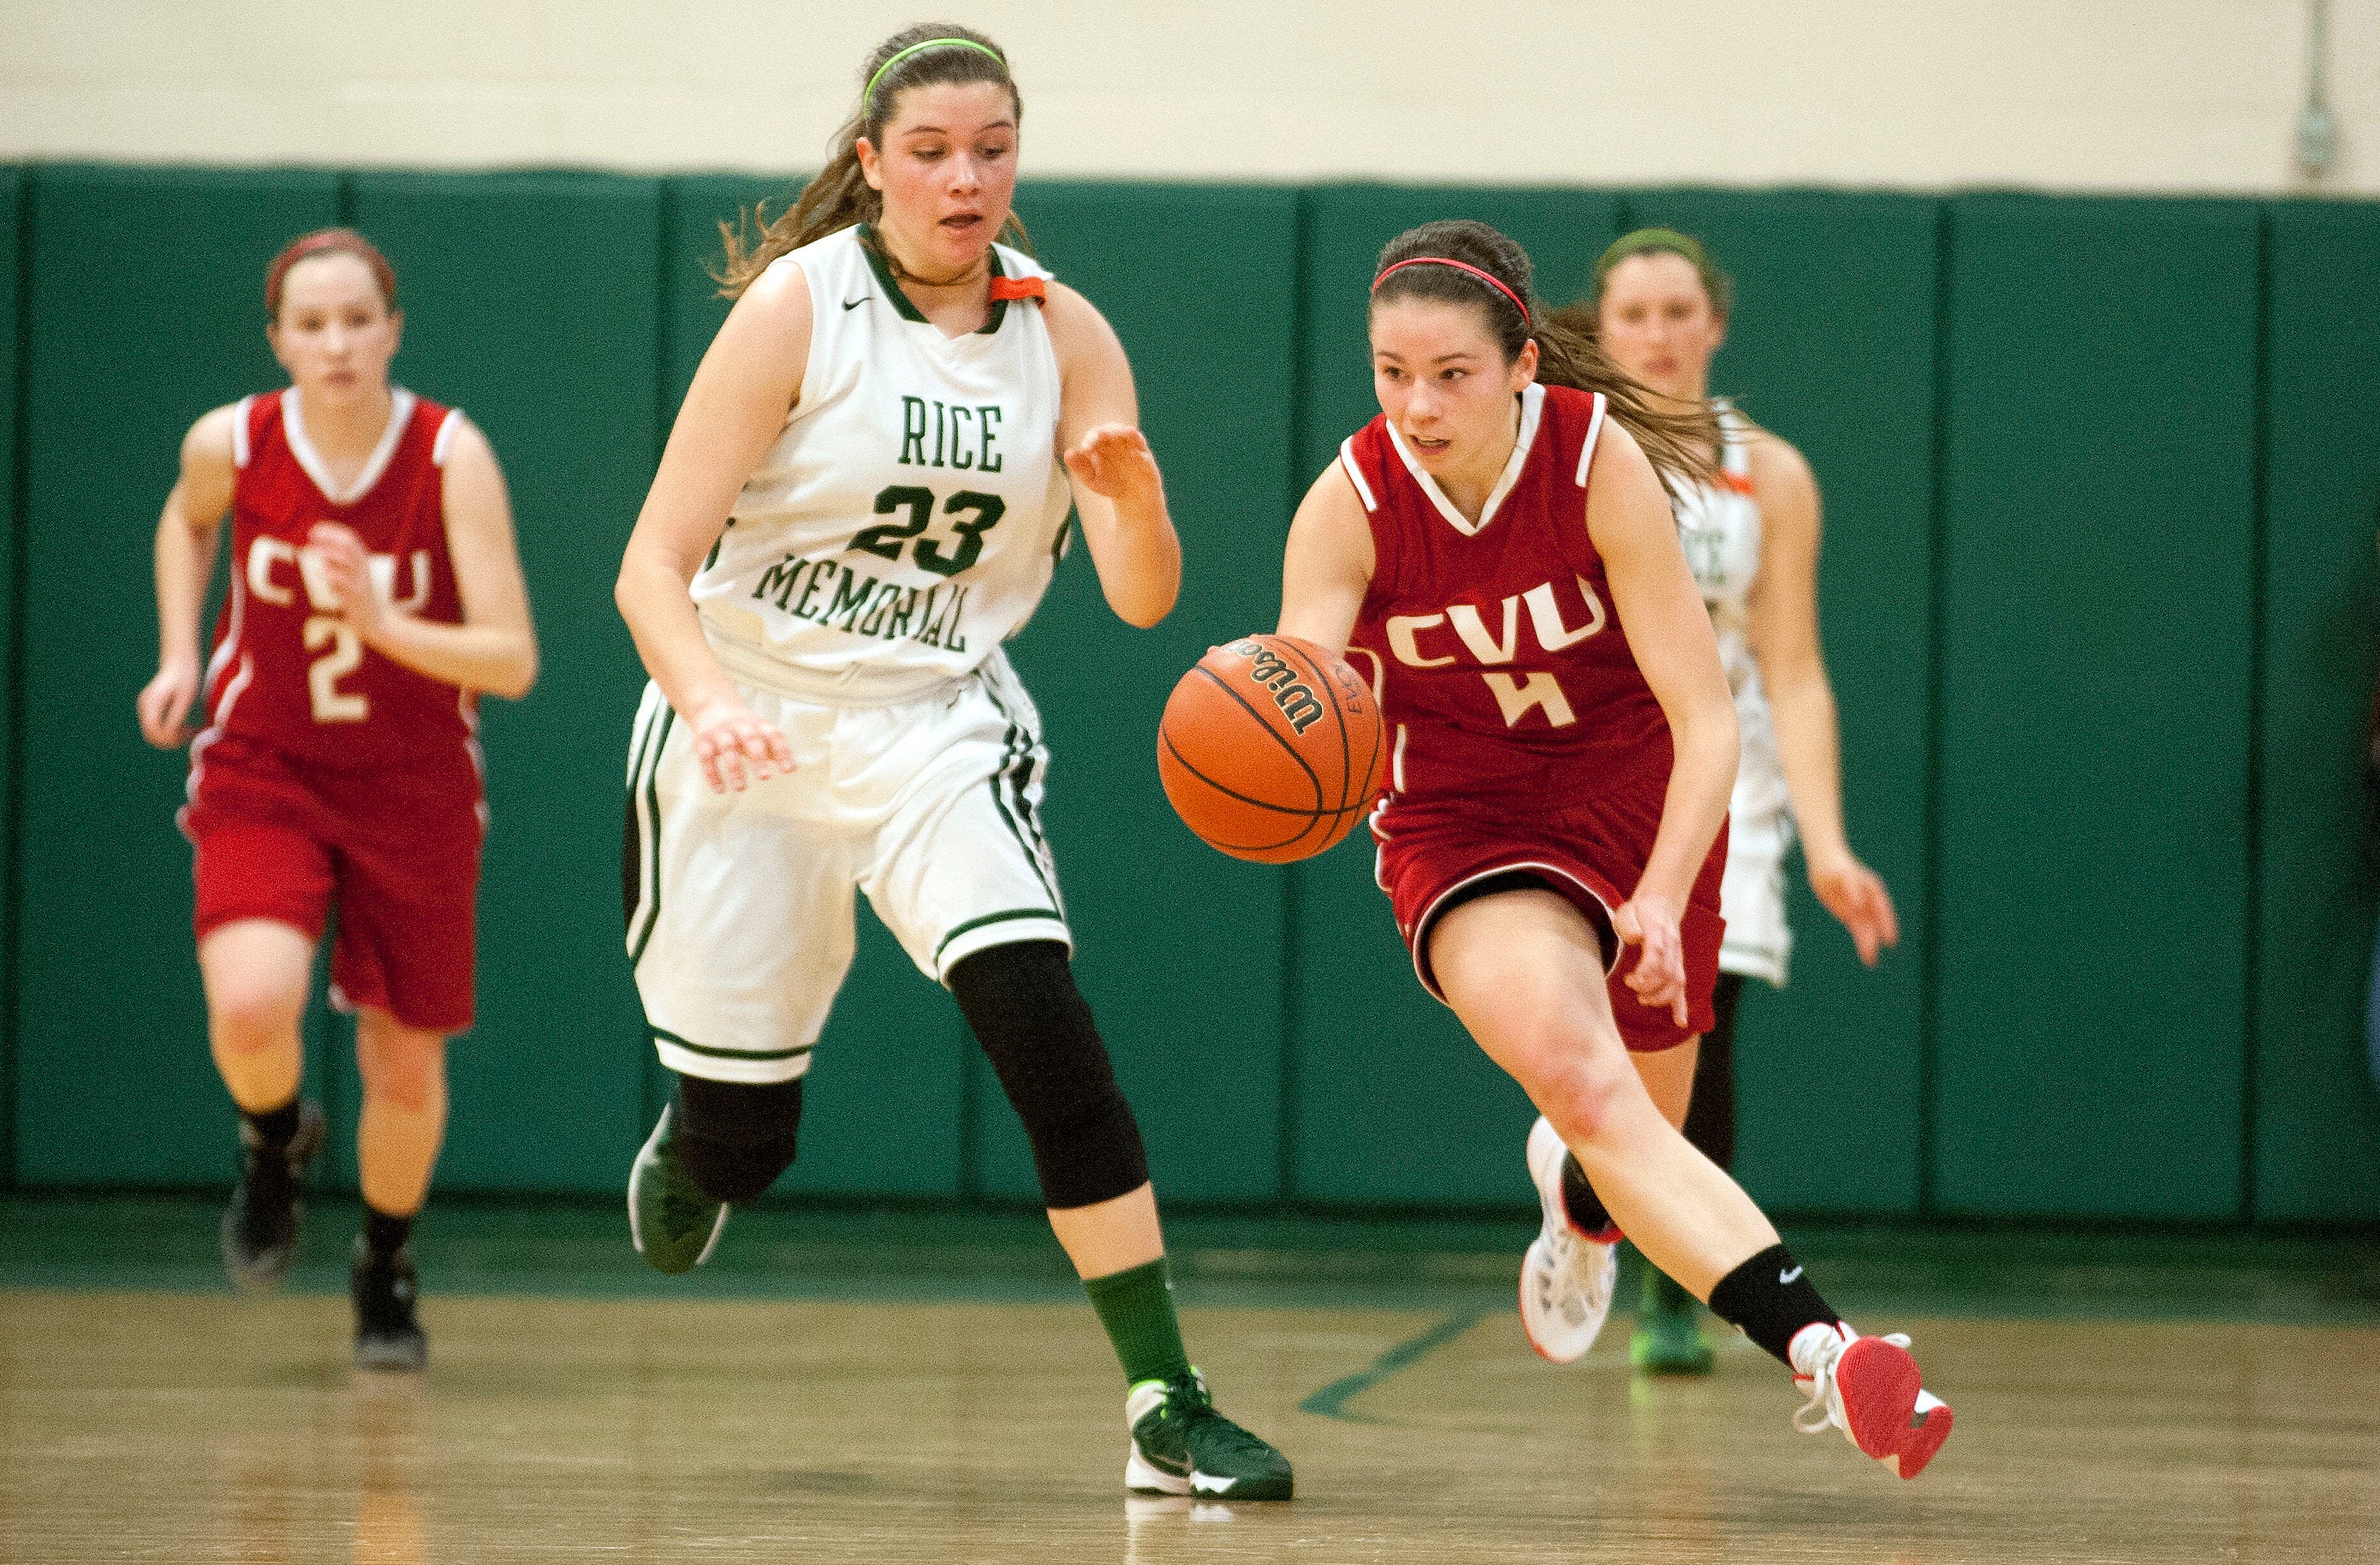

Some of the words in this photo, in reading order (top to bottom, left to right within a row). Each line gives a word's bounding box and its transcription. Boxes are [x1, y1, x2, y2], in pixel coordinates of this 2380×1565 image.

[898, 395, 1003, 473] RICE
[846, 485, 1006, 577] 23
[752, 552, 968, 653] MEMORIAL
[1386, 573, 1606, 667] CVU
[303, 616, 371, 724] 2
[1482, 671, 1577, 729] 4
